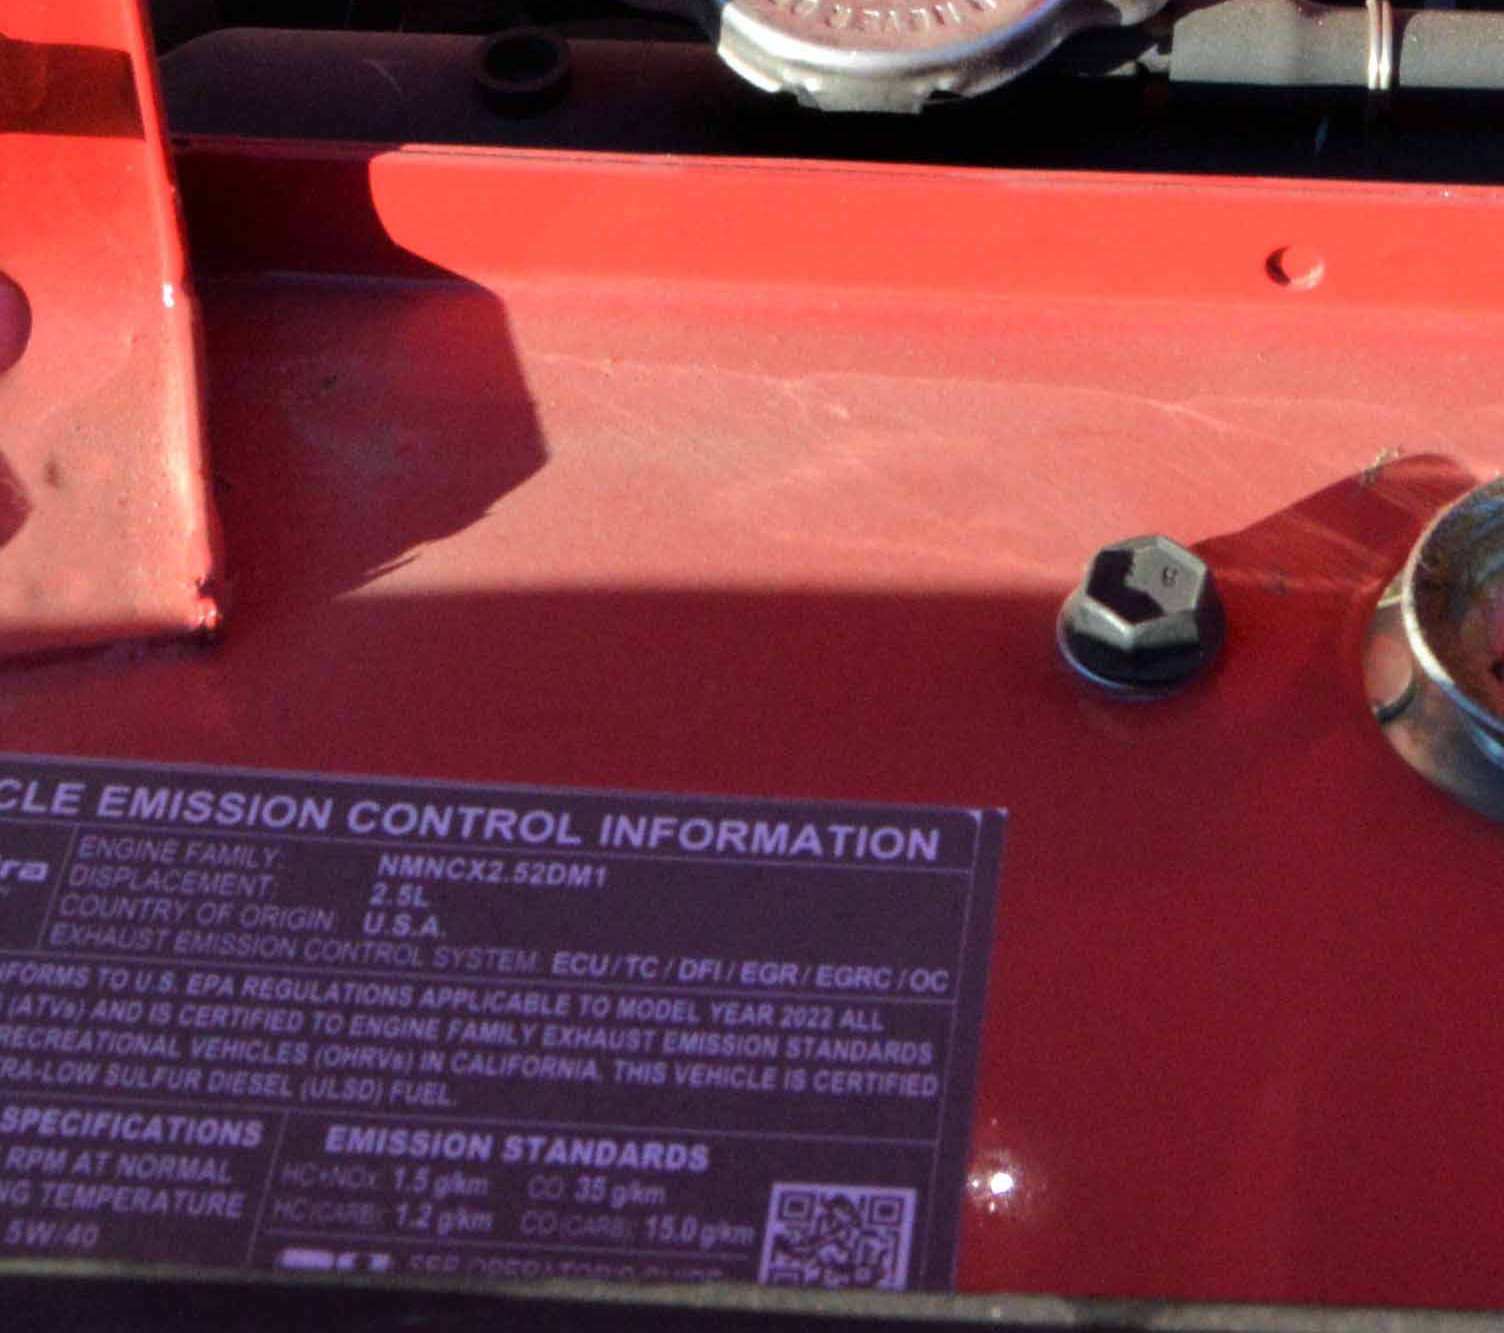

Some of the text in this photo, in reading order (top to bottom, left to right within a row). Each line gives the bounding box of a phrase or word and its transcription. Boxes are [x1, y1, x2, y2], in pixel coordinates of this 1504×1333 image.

[97, 785, 332, 829] EMISSION
[346, 800, 580, 845] CONTROL
[600, 816, 938, 860] INFORMATION
[77, 834, 178, 863] ENGINE
[378, 854, 605, 886] NMNCX2.52DM1
[368, 881, 428, 909] 2.5L
[59, 893, 189, 921] COUNTRY
[195, 900, 234, 926] OF
[362, 911, 439, 938] U.S.A.
[49, 921, 169, 950] EXHAUST
[173, 929, 296, 958] EMISSION
[303, 937, 421, 967] CONTROL
[97, 965, 130, 991] TO
[132, 969, 176, 995] U.S.
[185, 972, 234, 997] EPA
[241, 975, 412, 1006] REGULATIONS
[418, 986, 570, 1016] APPLICABLE
[578, 993, 611, 1018] TO
[616, 996, 699, 1024] MODEL
[710, 1001, 774, 1026] YEAR
[779, 1005, 833, 1030] 2022
[839, 1008, 883, 1033] ALL
[7, 993, 85, 1021] (ATVs)
[89, 999, 143, 1023] AND
[147, 1001, 172, 1025] IS
[178, 1003, 304, 1033] CERTIFIED
[312, 1010, 344, 1035] TO
[348, 1014, 439, 1041] ENGINE
[446, 1018, 536, 1046] FAMILY
[542, 1024, 654, 1051] EXHAUST
[662, 1031, 778, 1056] EMISSION
[786, 1036, 932, 1064] STANDARDS
[103, 1062, 202, 1090] SULFUR
[207, 1069, 290, 1097] DIESEL
[300, 1077, 383, 1102] (ULSD)
[190, 1037, 308, 1065] VEHICLES
[419, 1050, 444, 1073] IN
[614, 1059, 666, 1085] THIS
[674, 1063, 776, 1091] VEHICLE
[783, 1067, 807, 1093] IS
[812, 1069, 938, 1097] CERTIFIED
[0, 1107, 261, 1146] SPECIFICATIONS
[5, 1146, 67, 1172] RPM
[71, 1150, 111, 1174] AT
[117, 1154, 229, 1183] NORMAL
[325, 1126, 707, 1171] EMISSION STANDARDS
[42, 1182, 243, 1218] TEMPERATURE
[393, 1166, 430, 1194] 1.5
[575, 1175, 606, 1203] 35
[396, 1201, 433, 1231] 1.2
[646, 1214, 698, 1243] 15.0
